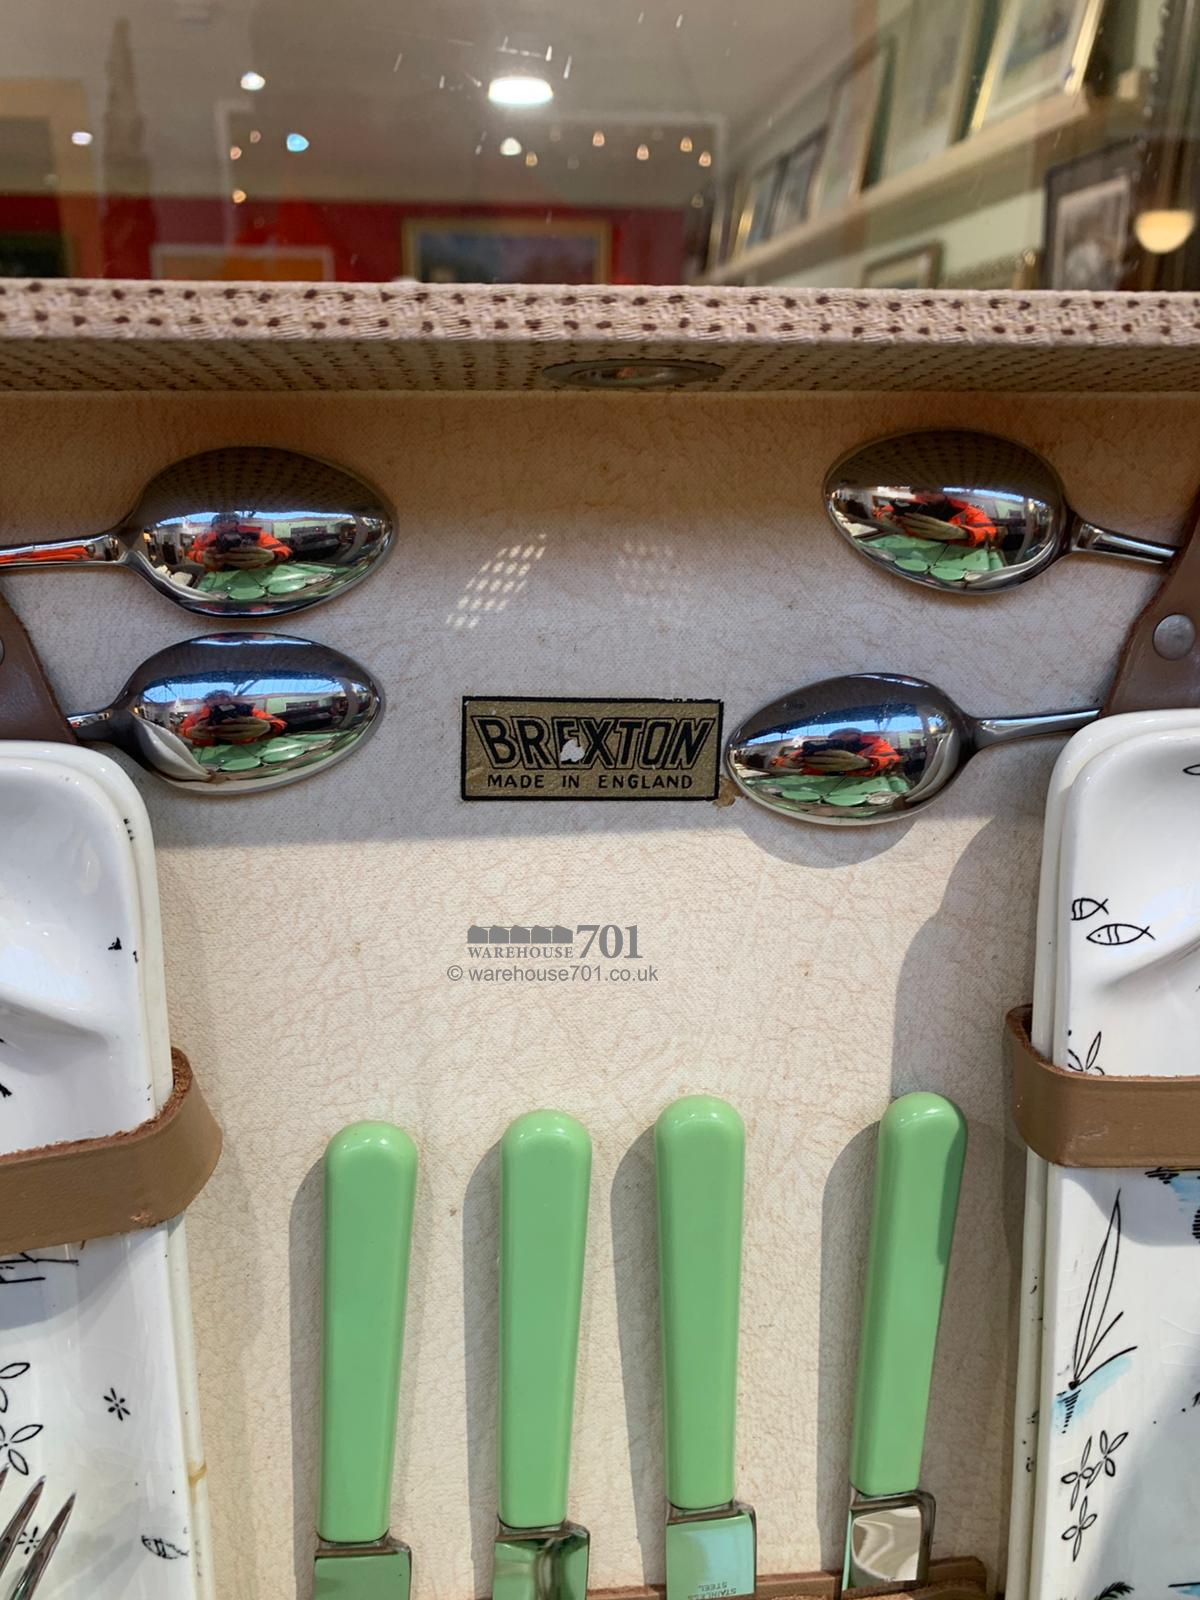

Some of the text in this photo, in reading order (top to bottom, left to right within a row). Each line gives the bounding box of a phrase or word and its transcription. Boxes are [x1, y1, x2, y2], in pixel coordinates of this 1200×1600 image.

[471, 715, 716, 770] BREXTON
[487, 774, 693, 789] MADE IN ENGLAND
